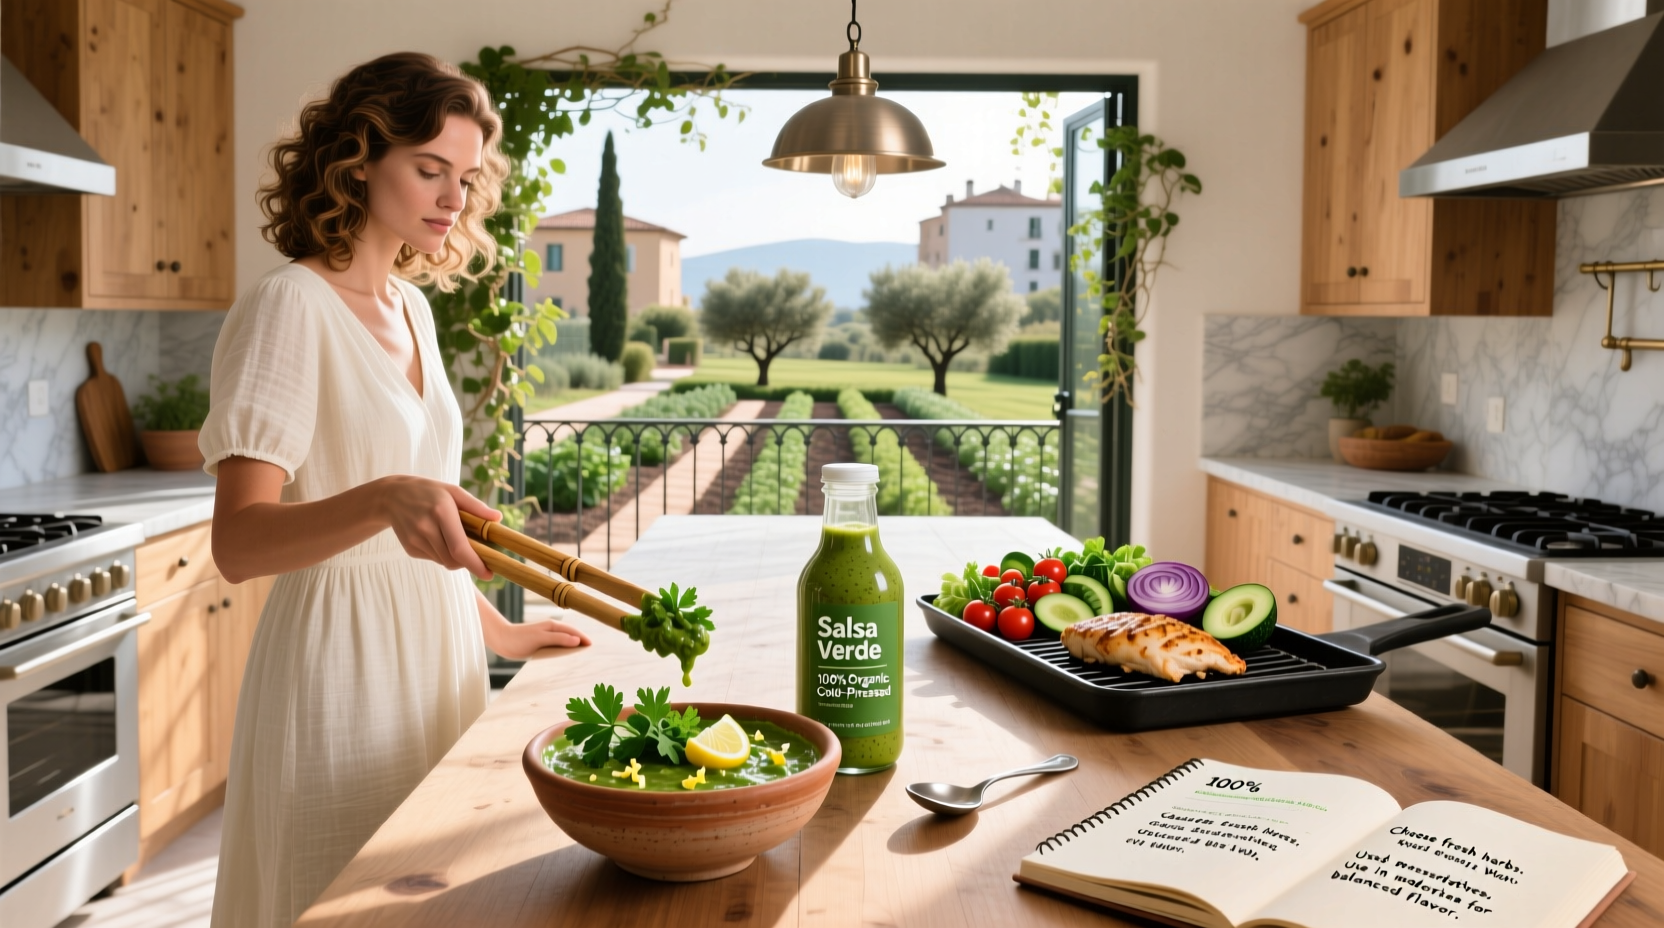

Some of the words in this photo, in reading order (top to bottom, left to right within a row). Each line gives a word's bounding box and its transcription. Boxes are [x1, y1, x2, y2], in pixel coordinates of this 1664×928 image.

[818, 616, 878, 638] Salsa
[817, 640, 882, 660] Verde
[817, 673, 847, 685] 100%
[848, 672, 890, 688] Organic
[1205, 776, 1263, 793] 100%
[1441, 837, 1477, 857] fresh
[1331, 870, 1403, 896] balanced
[1406, 892, 1459, 920] flavor.
[1467, 900, 1493, 914] for
